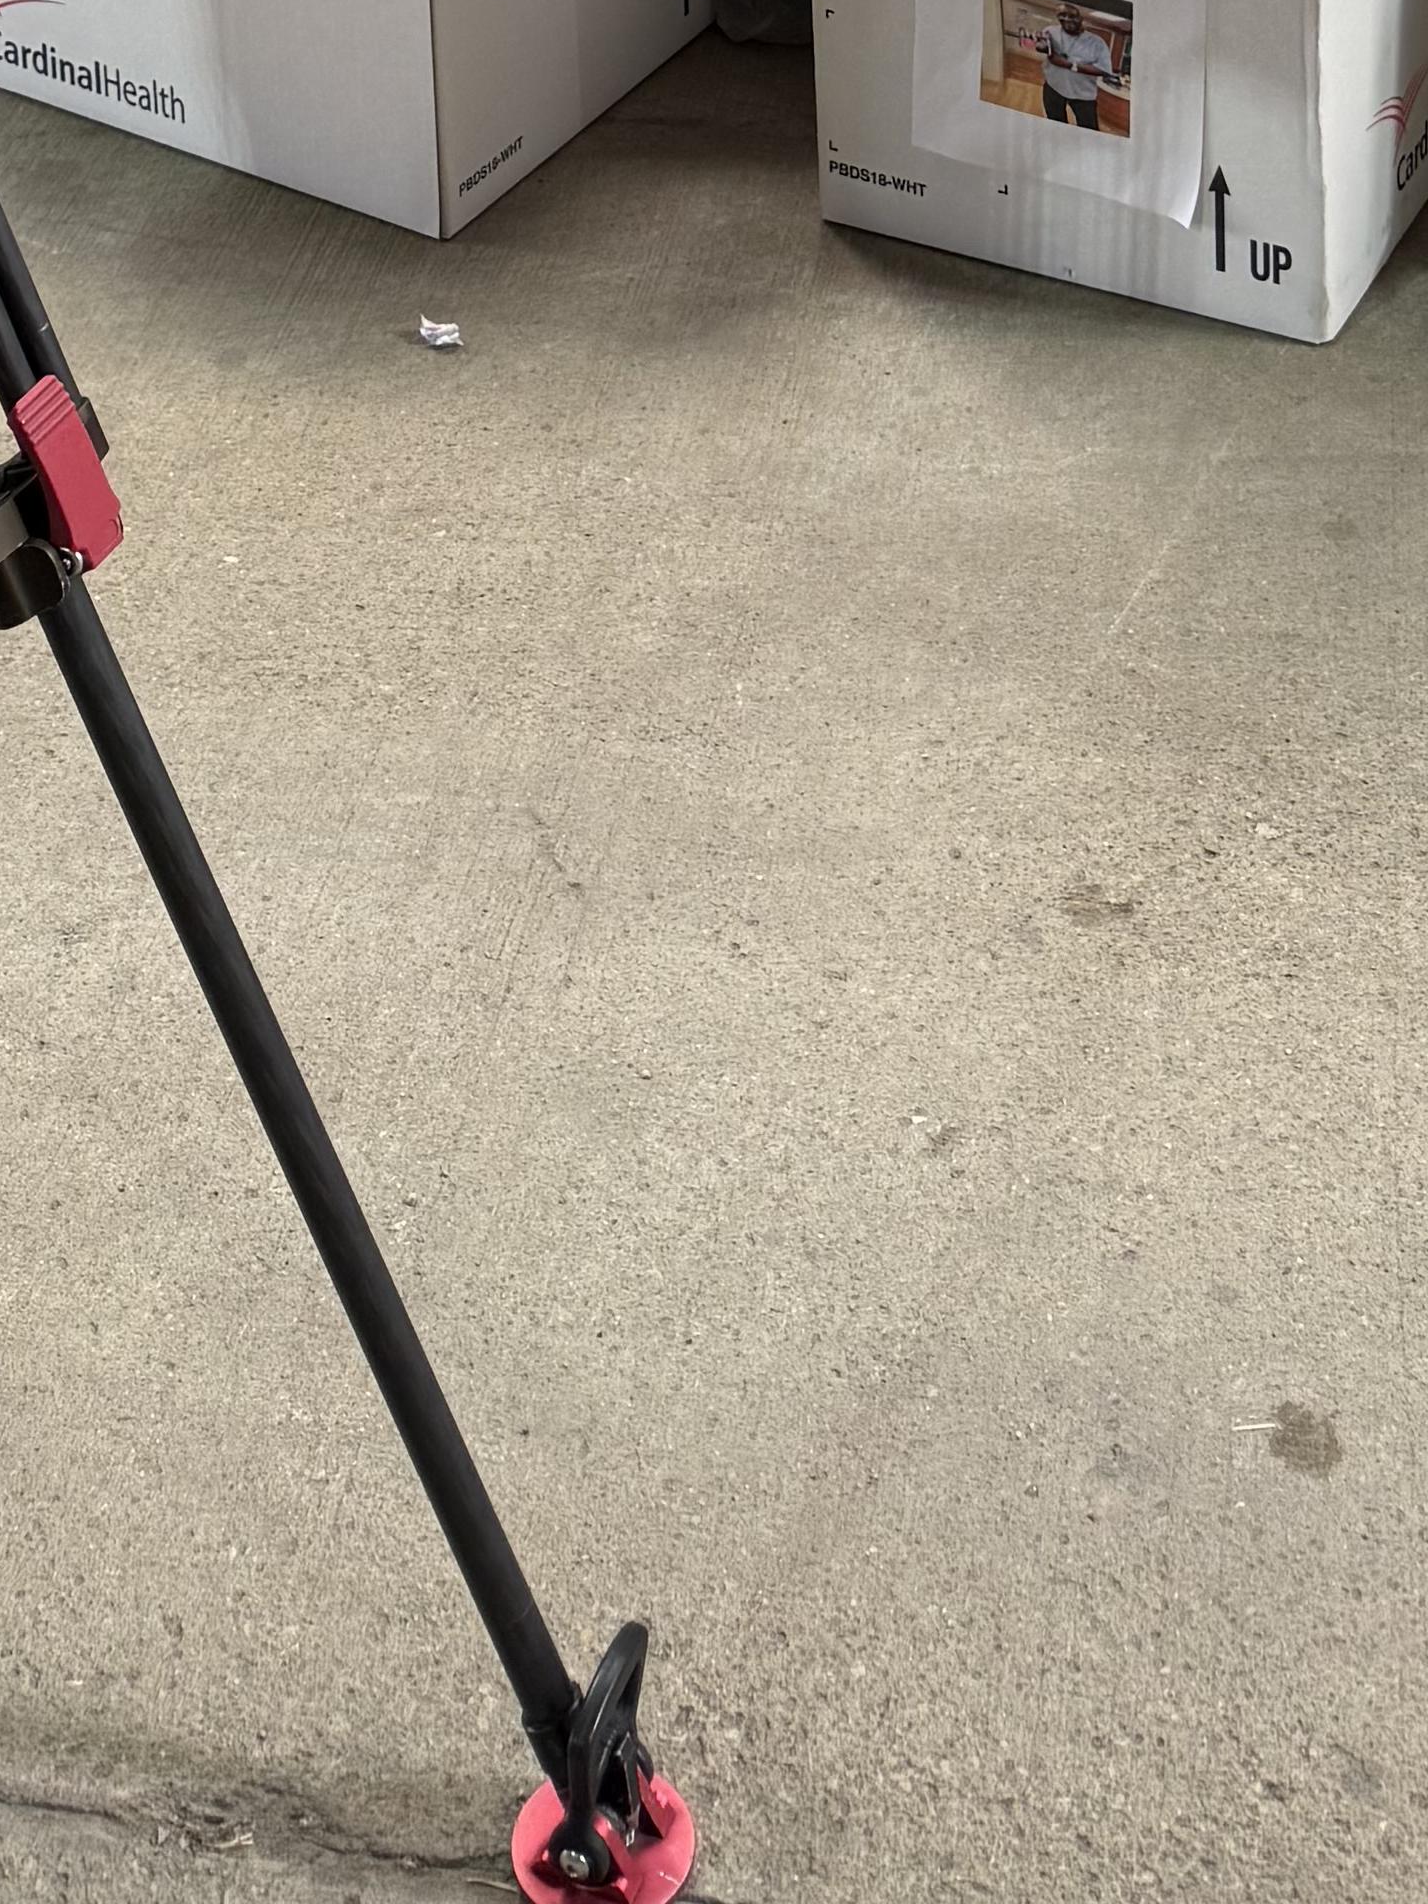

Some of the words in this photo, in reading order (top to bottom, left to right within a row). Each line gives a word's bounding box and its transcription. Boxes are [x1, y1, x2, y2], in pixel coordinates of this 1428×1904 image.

[458, 135, 524, 198] PBDS18-WHT
[828, 160, 927, 197] PBDS18-WHT
[1250, 239, 1292, 285] UP
